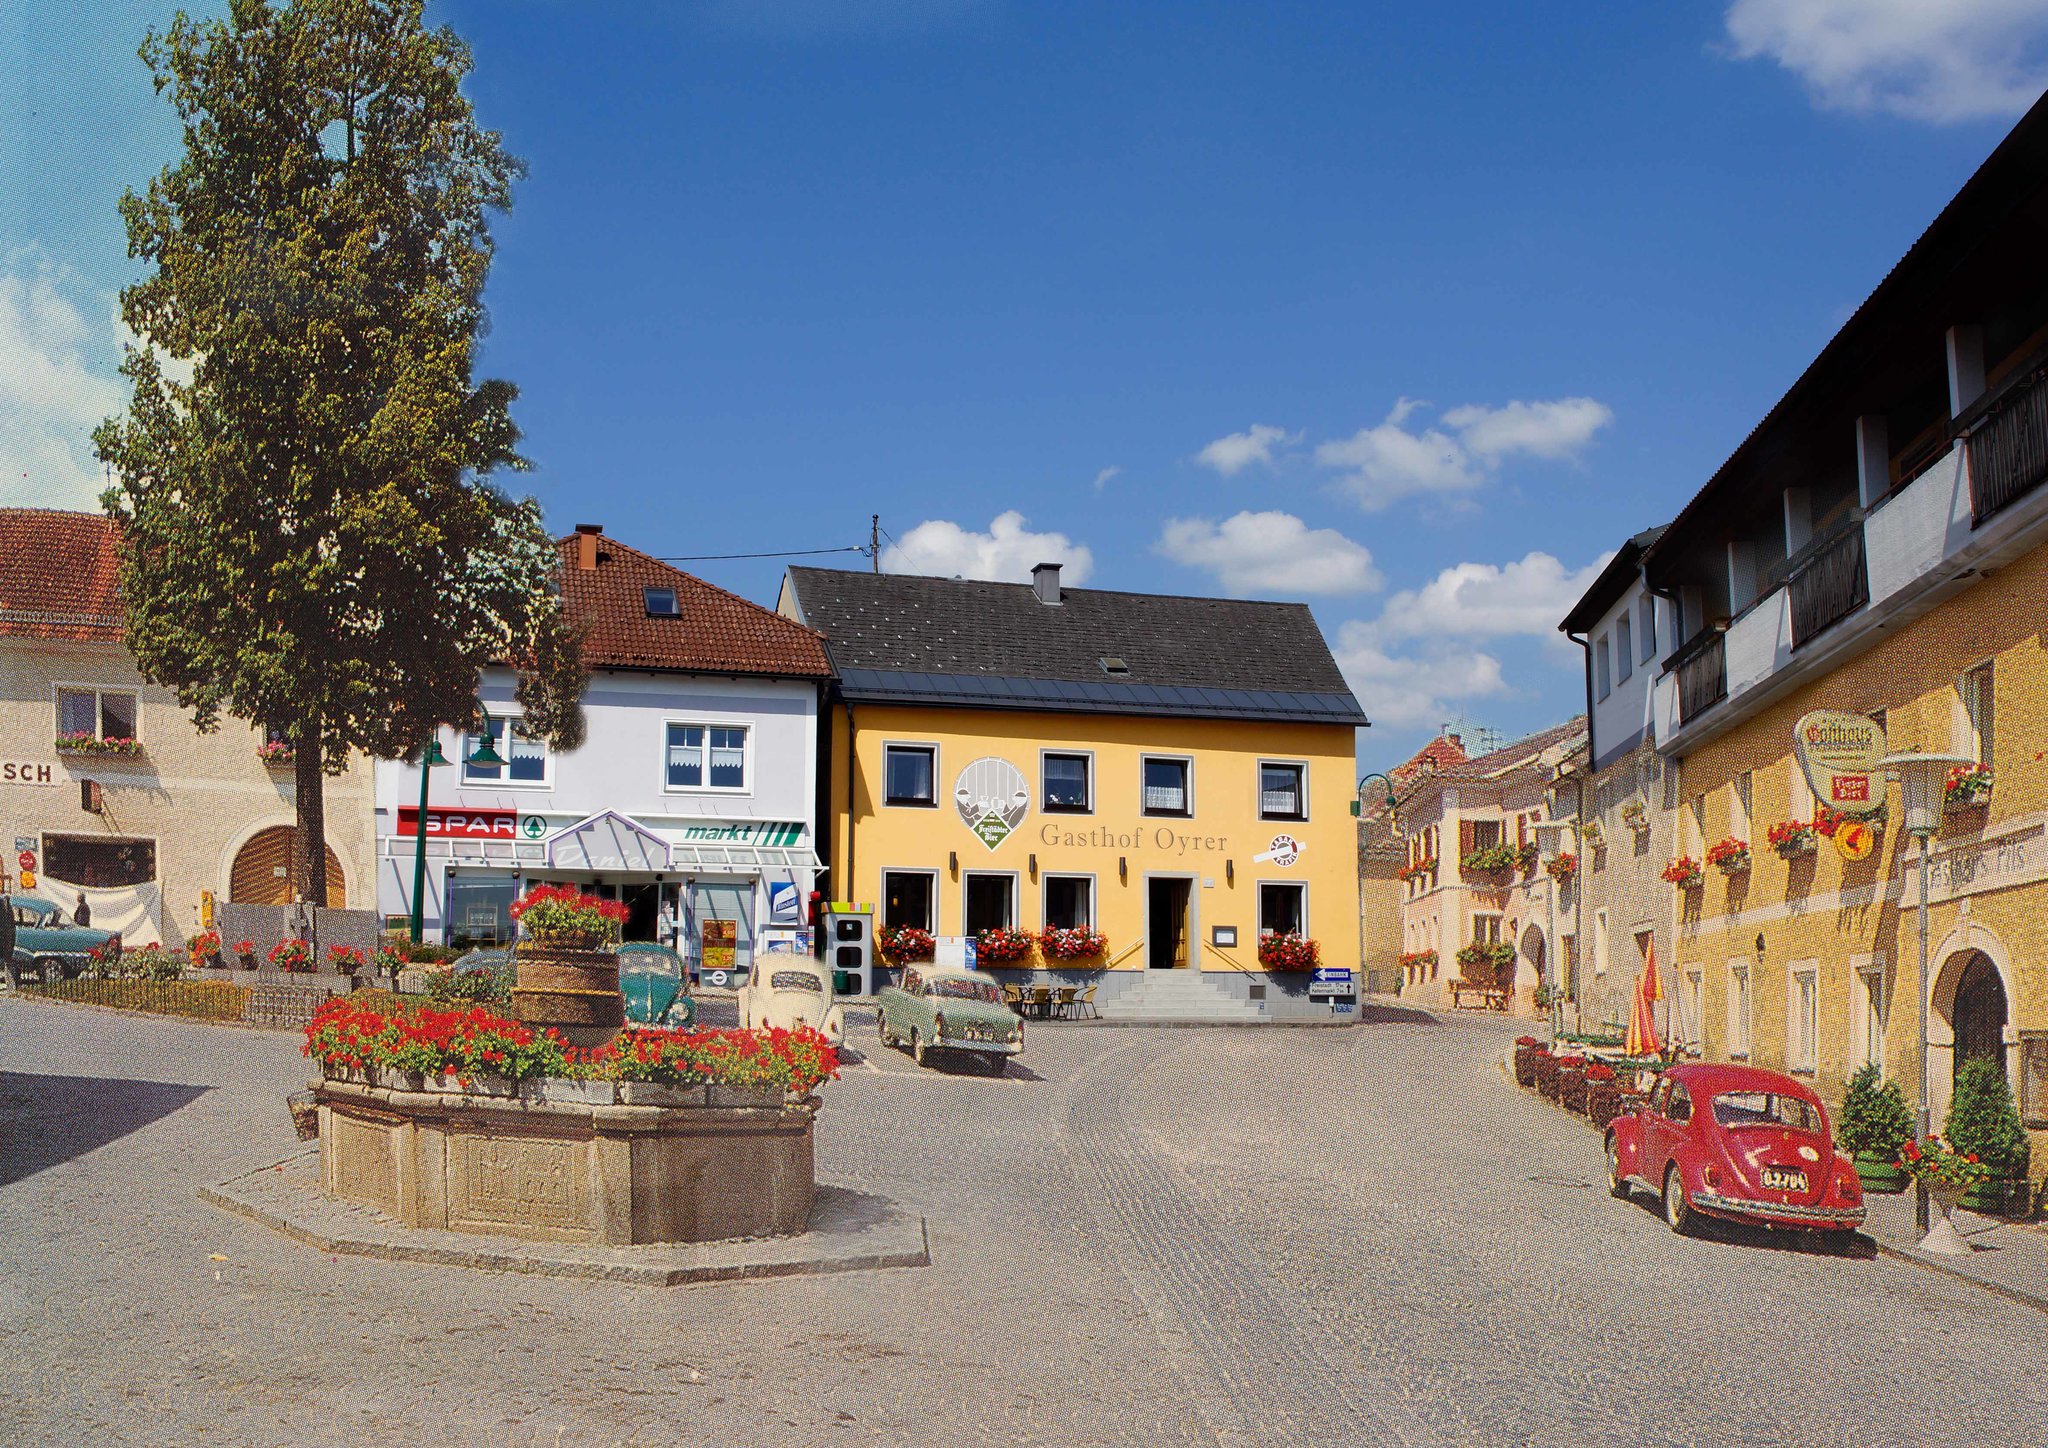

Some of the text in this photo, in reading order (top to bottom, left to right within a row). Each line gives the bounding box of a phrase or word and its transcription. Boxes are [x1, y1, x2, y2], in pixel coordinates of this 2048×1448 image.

[4, 763, 51, 782] SCH
[425, 815, 515, 834] SPAR
[685, 824, 753, 841] markt
[984, 832, 999, 842] Bier
[1040, 823, 1228, 857] Gasthof Oyrer
[1271, 836, 1293, 850] TABAK
[556, 844, 656, 868] Daniel
